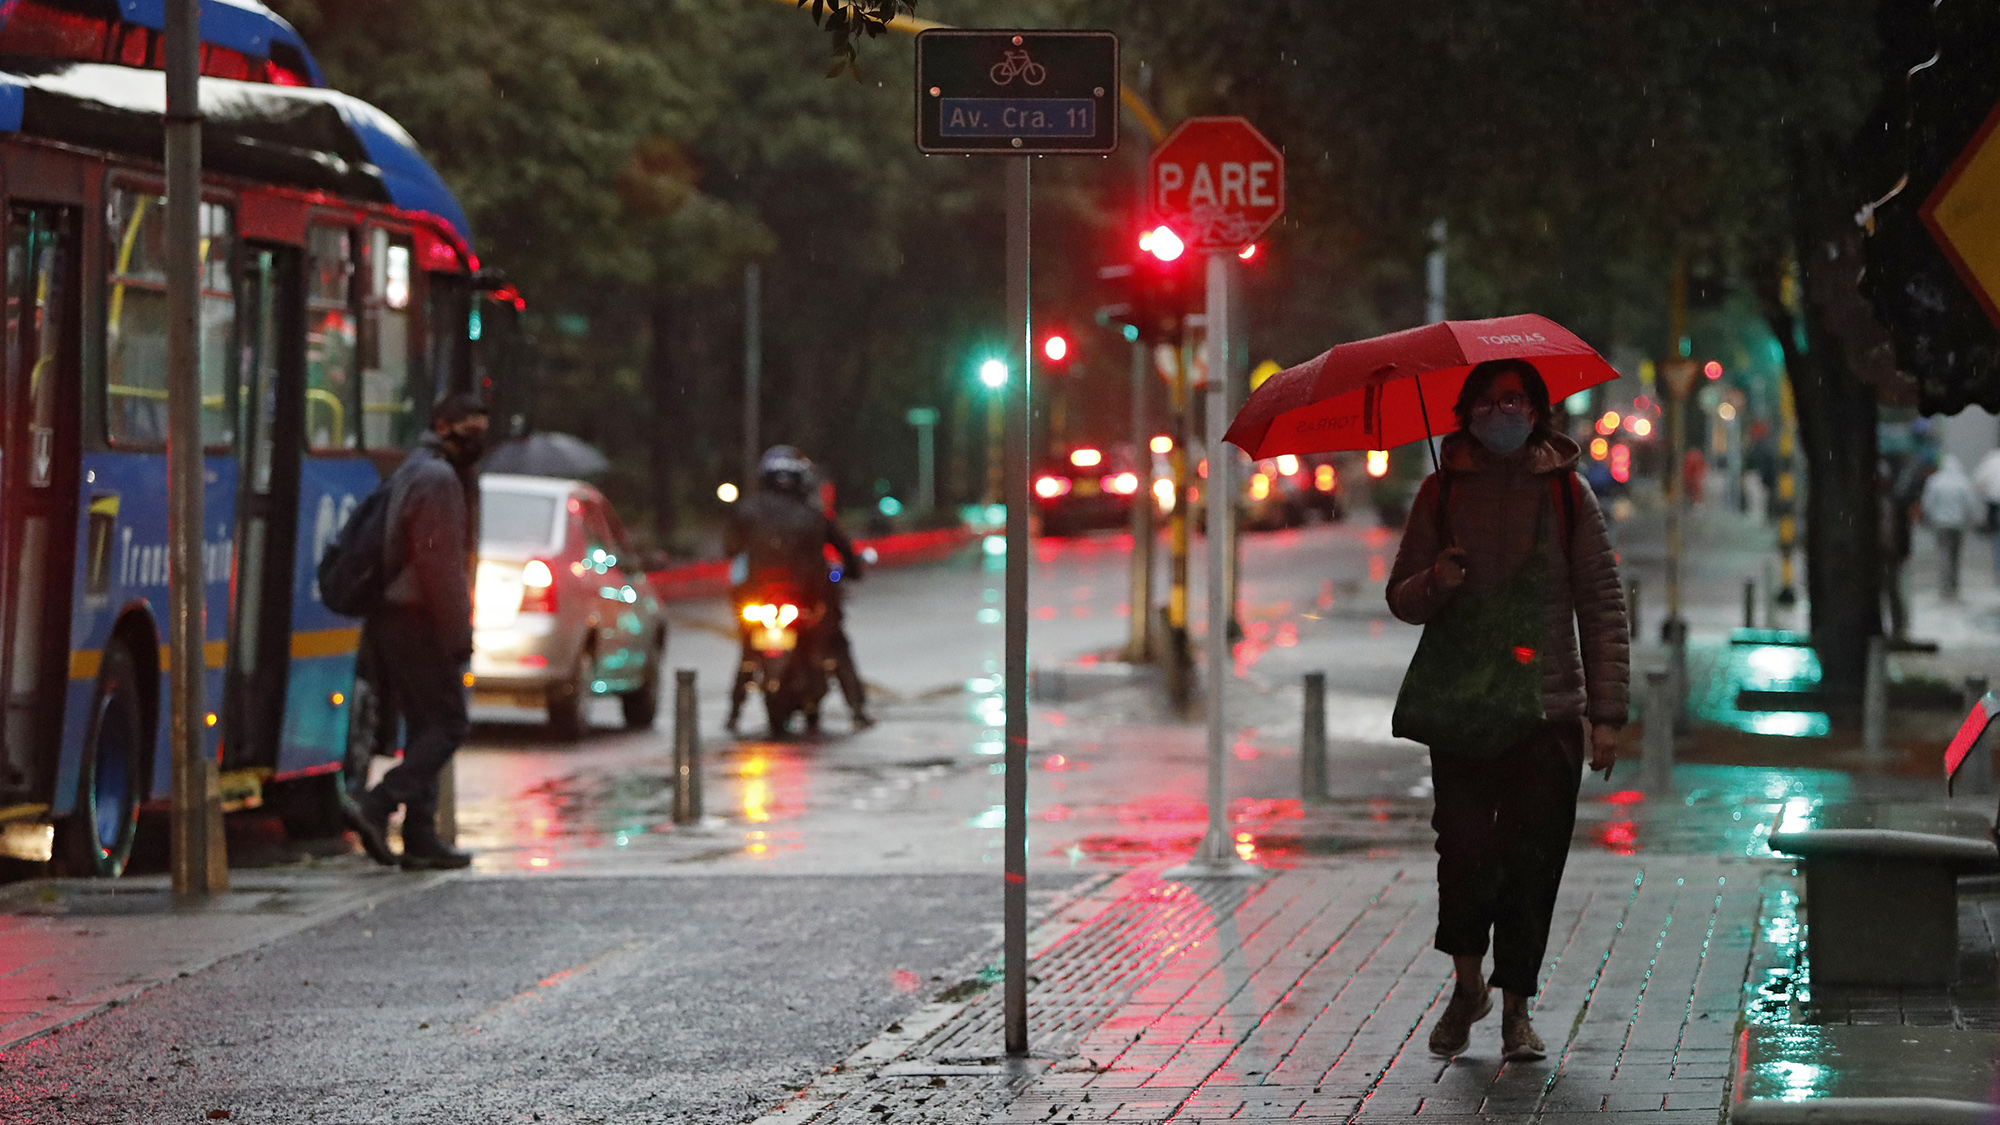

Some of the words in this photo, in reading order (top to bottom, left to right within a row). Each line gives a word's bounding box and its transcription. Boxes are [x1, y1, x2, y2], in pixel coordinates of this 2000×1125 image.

[950, 106, 988, 128] Av.
[1003, 106, 1053, 129] Cra.
[1066, 107, 1087, 129] 11
[1158, 161, 1275, 207] PARE
